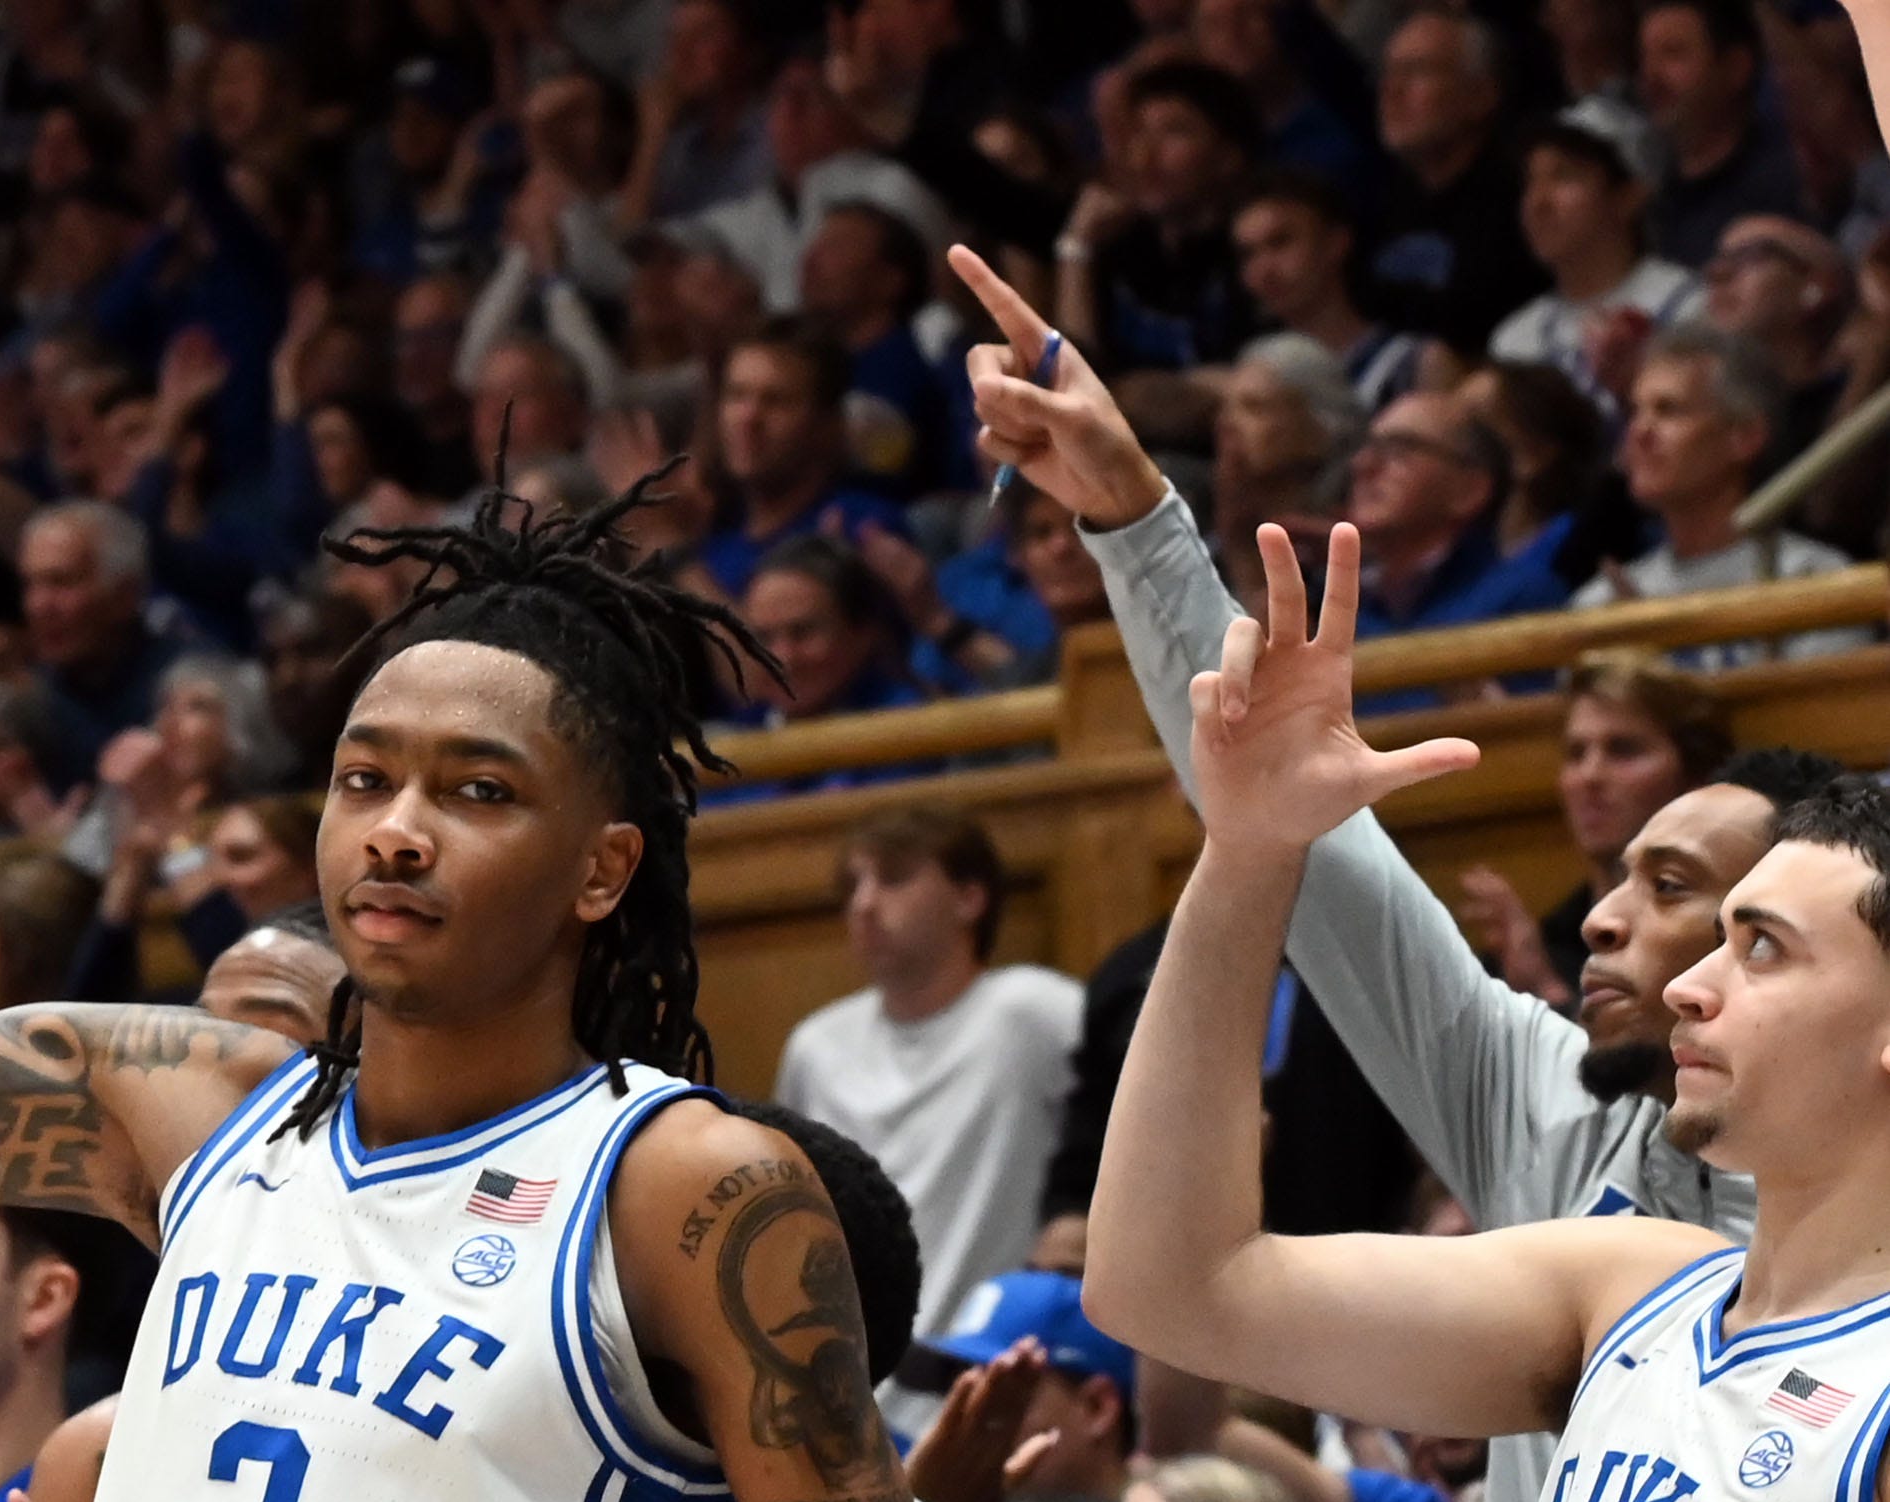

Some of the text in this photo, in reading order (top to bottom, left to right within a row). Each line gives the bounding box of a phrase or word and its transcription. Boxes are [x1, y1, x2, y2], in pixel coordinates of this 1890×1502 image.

[707, 1164, 757, 1210] NOT
[462, 1249, 513, 1271] ACC
[163, 1272, 506, 1440] DUKE
[1749, 1449, 1791, 1473] ACC
